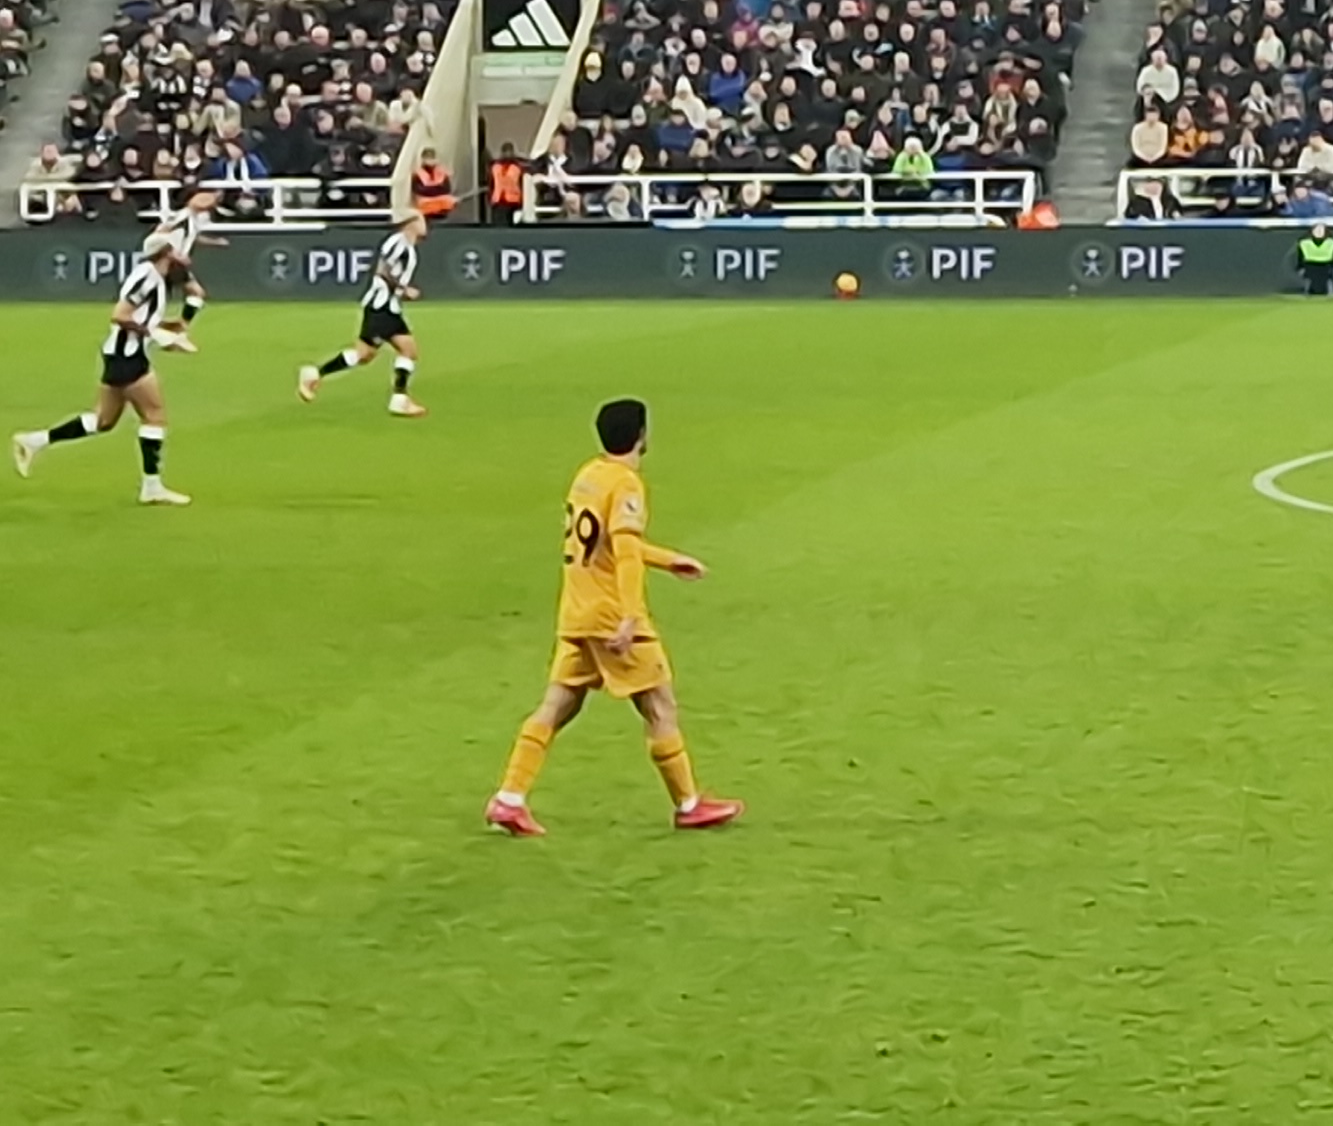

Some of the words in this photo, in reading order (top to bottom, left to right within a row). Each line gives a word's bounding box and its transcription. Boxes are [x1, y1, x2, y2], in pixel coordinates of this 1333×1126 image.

[309, 250, 372, 282] PIF
[501, 249, 565, 281] PIF
[716, 248, 780, 280] PIF
[932, 247, 996, 280] PIF
[1120, 246, 1184, 279] PIF
